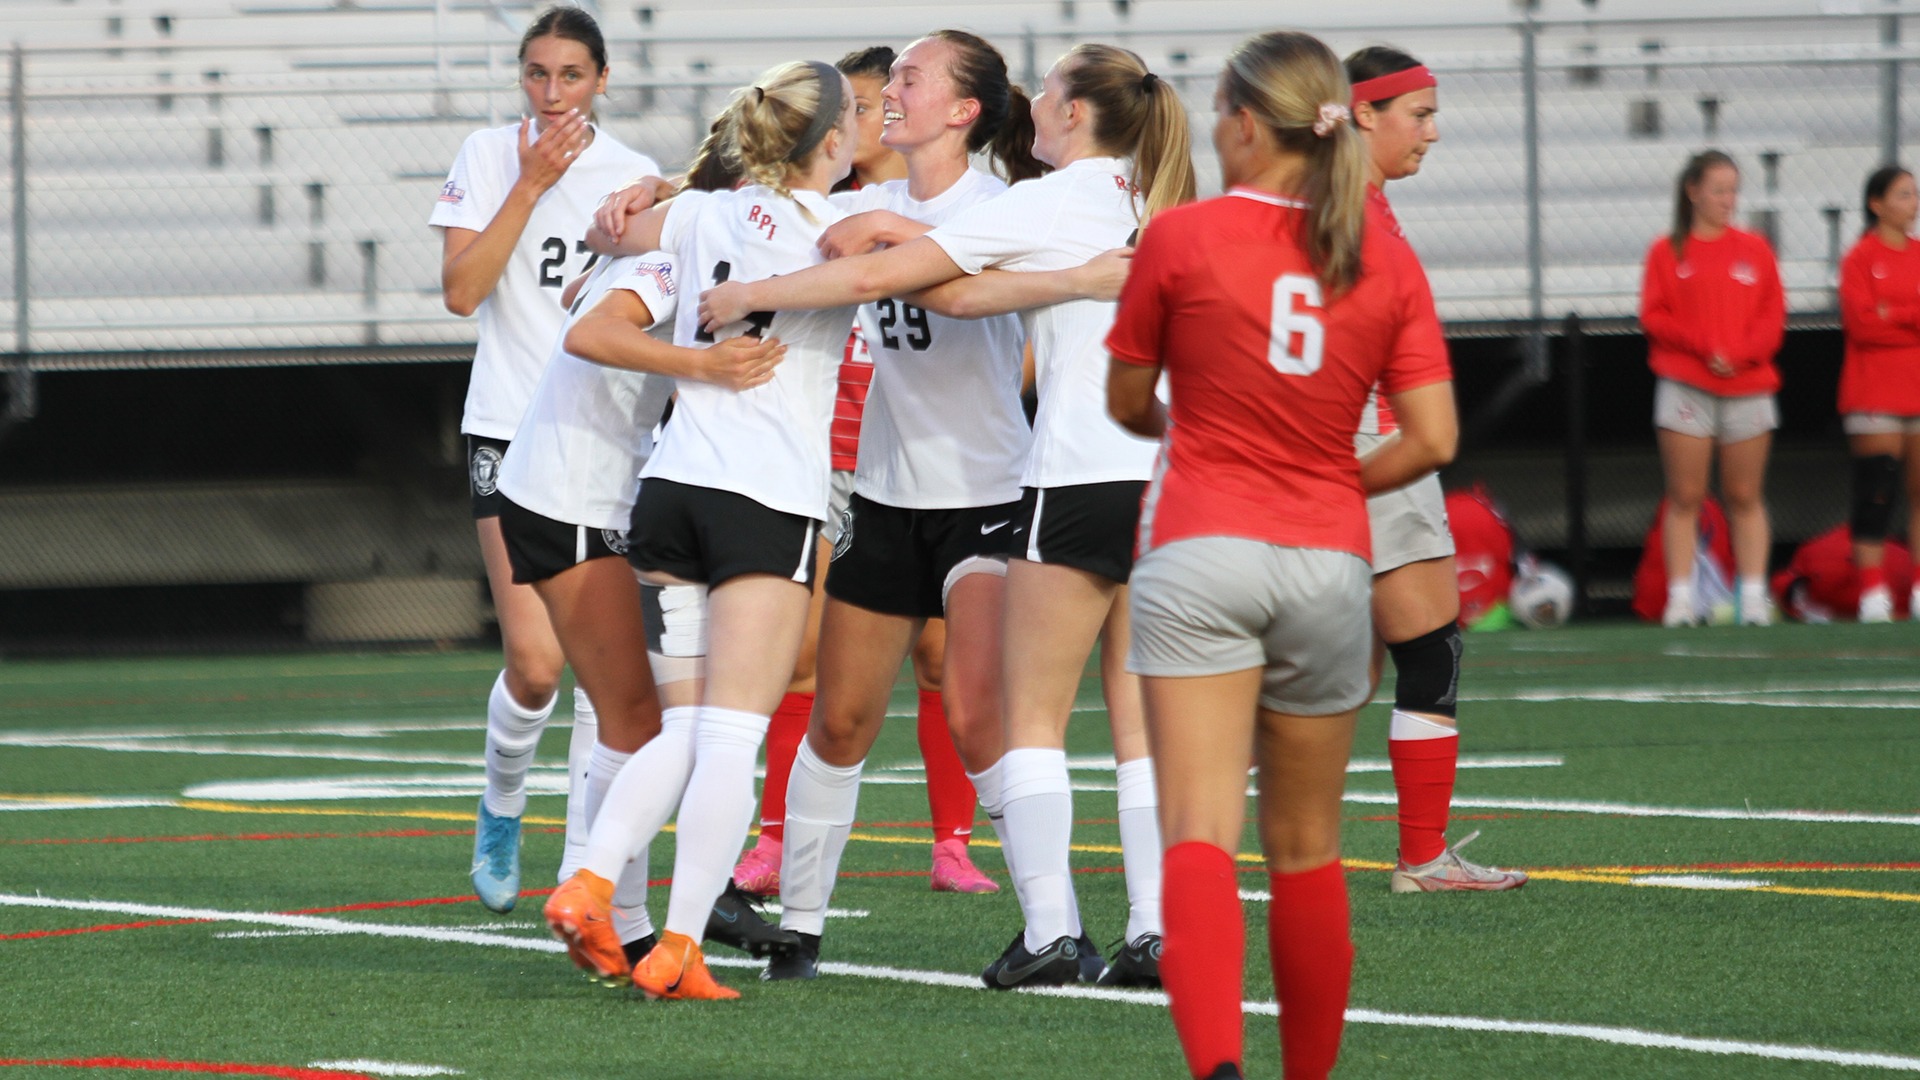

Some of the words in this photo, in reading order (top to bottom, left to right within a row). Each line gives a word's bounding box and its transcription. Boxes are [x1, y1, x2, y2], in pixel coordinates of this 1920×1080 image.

[748, 205, 778, 240] RPI
[877, 298, 932, 351] 29
[1268, 274, 1325, 376] 6
